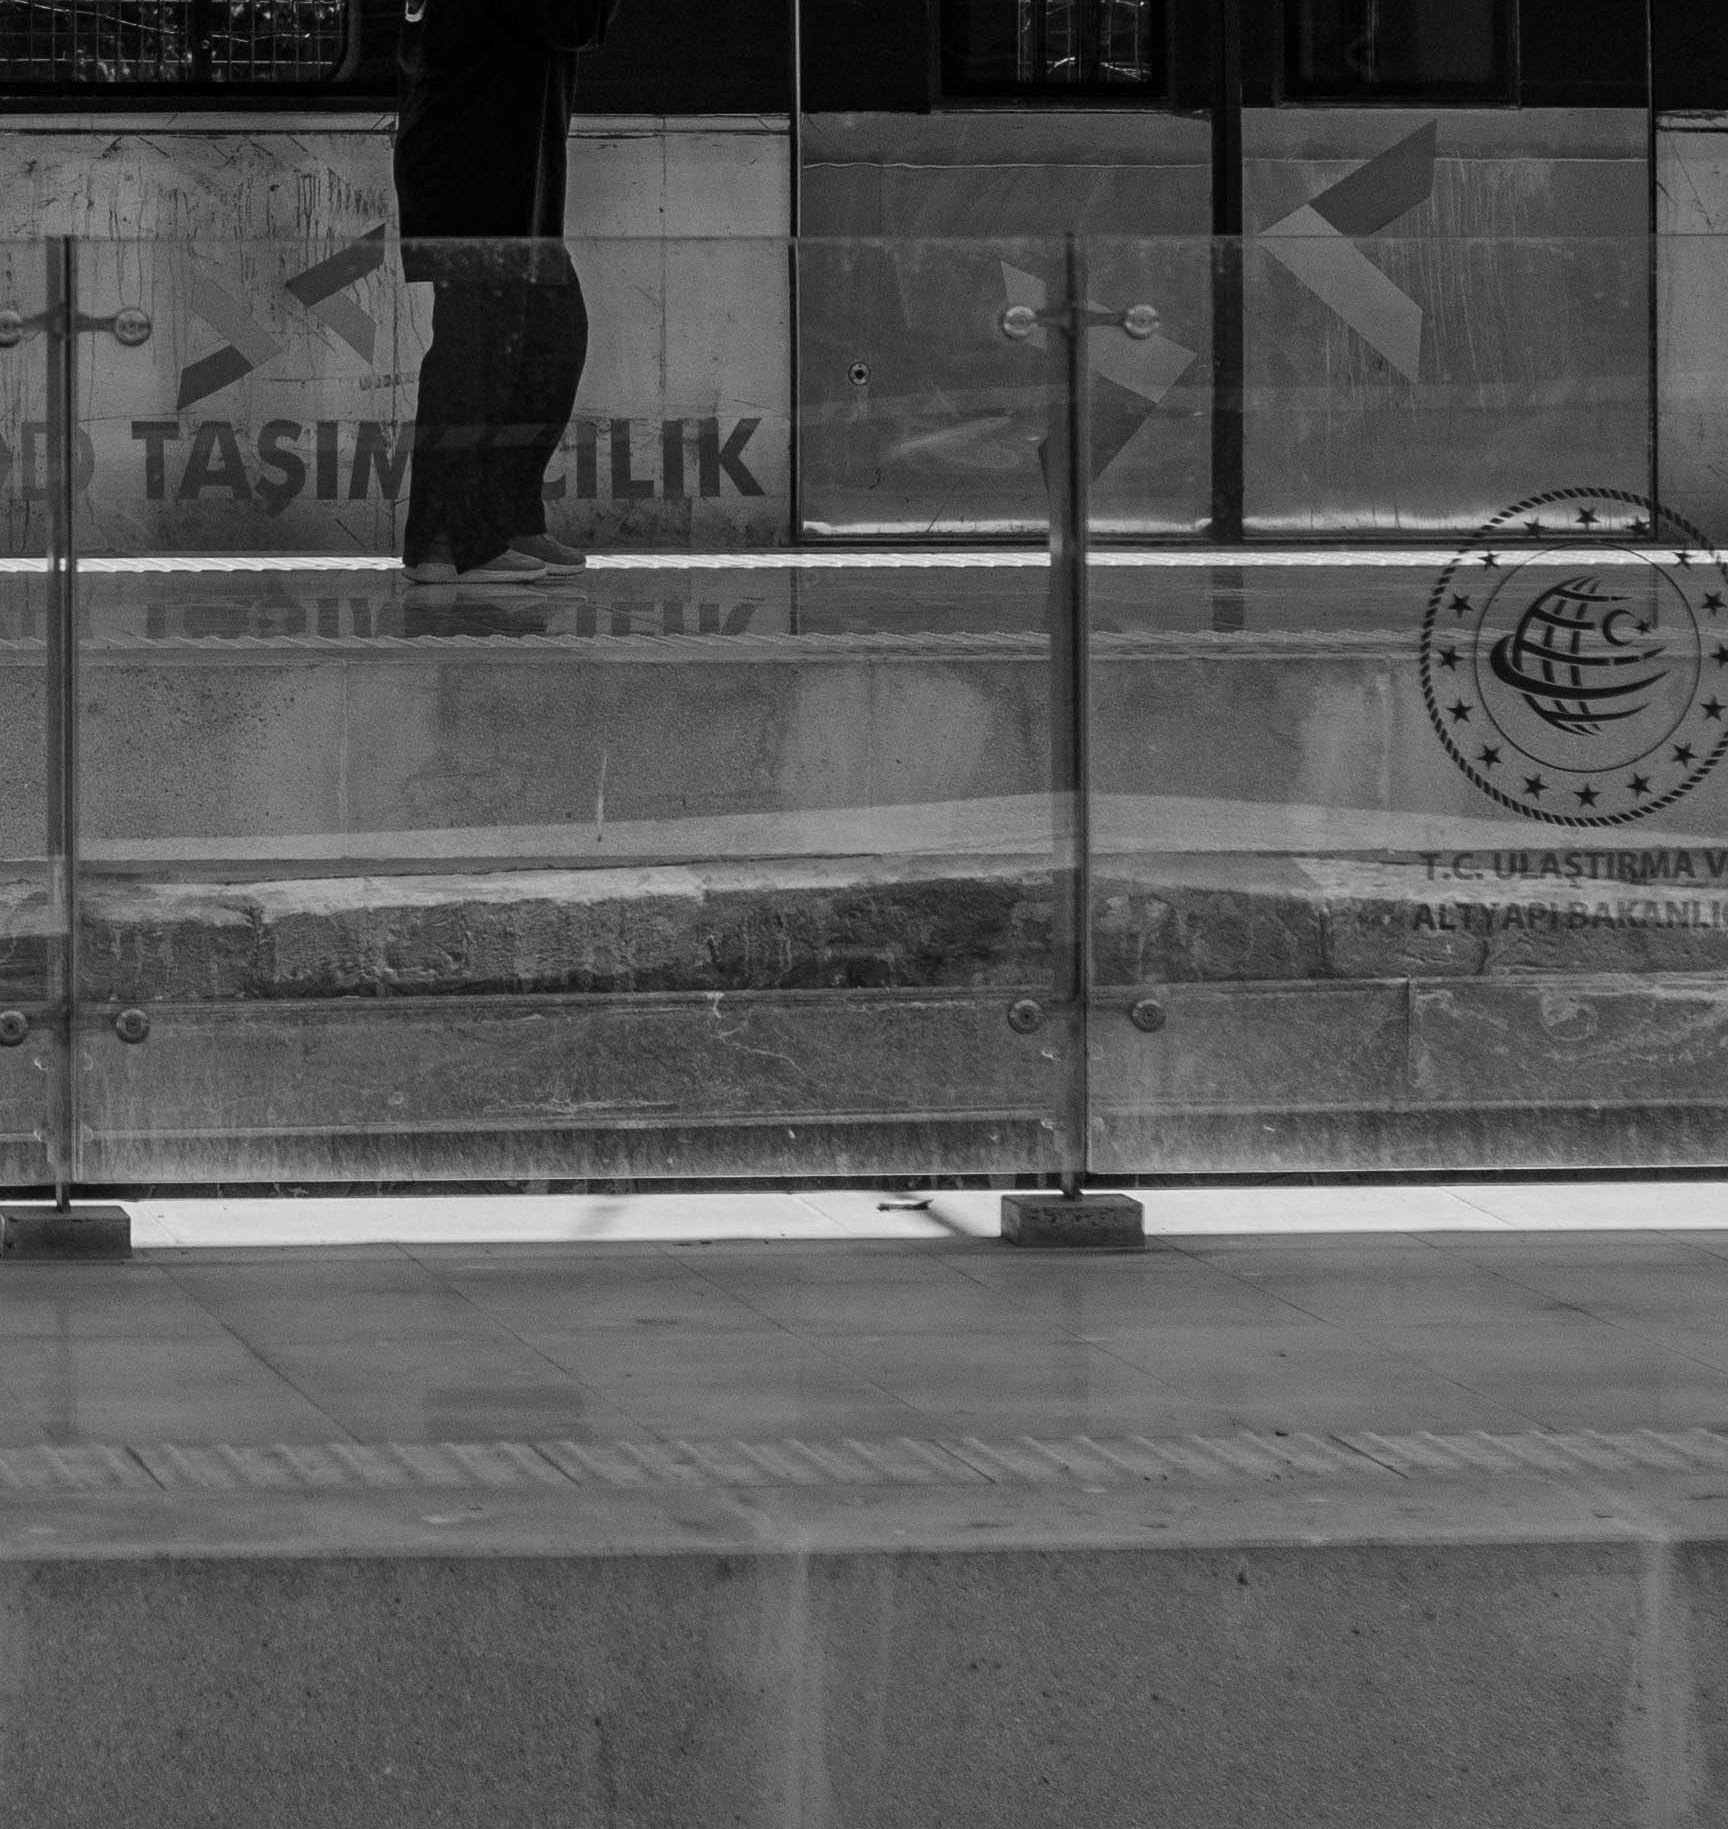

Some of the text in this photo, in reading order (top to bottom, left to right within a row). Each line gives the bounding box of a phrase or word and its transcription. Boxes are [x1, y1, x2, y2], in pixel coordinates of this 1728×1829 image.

[131, 417, 765, 517] TAŞIMILIK
[1419, 851, 1484, 881] T.C.
[1494, 849, 1695, 888] ULAŞTIRMA
[1413, 902, 1561, 933] ALTYAPI
